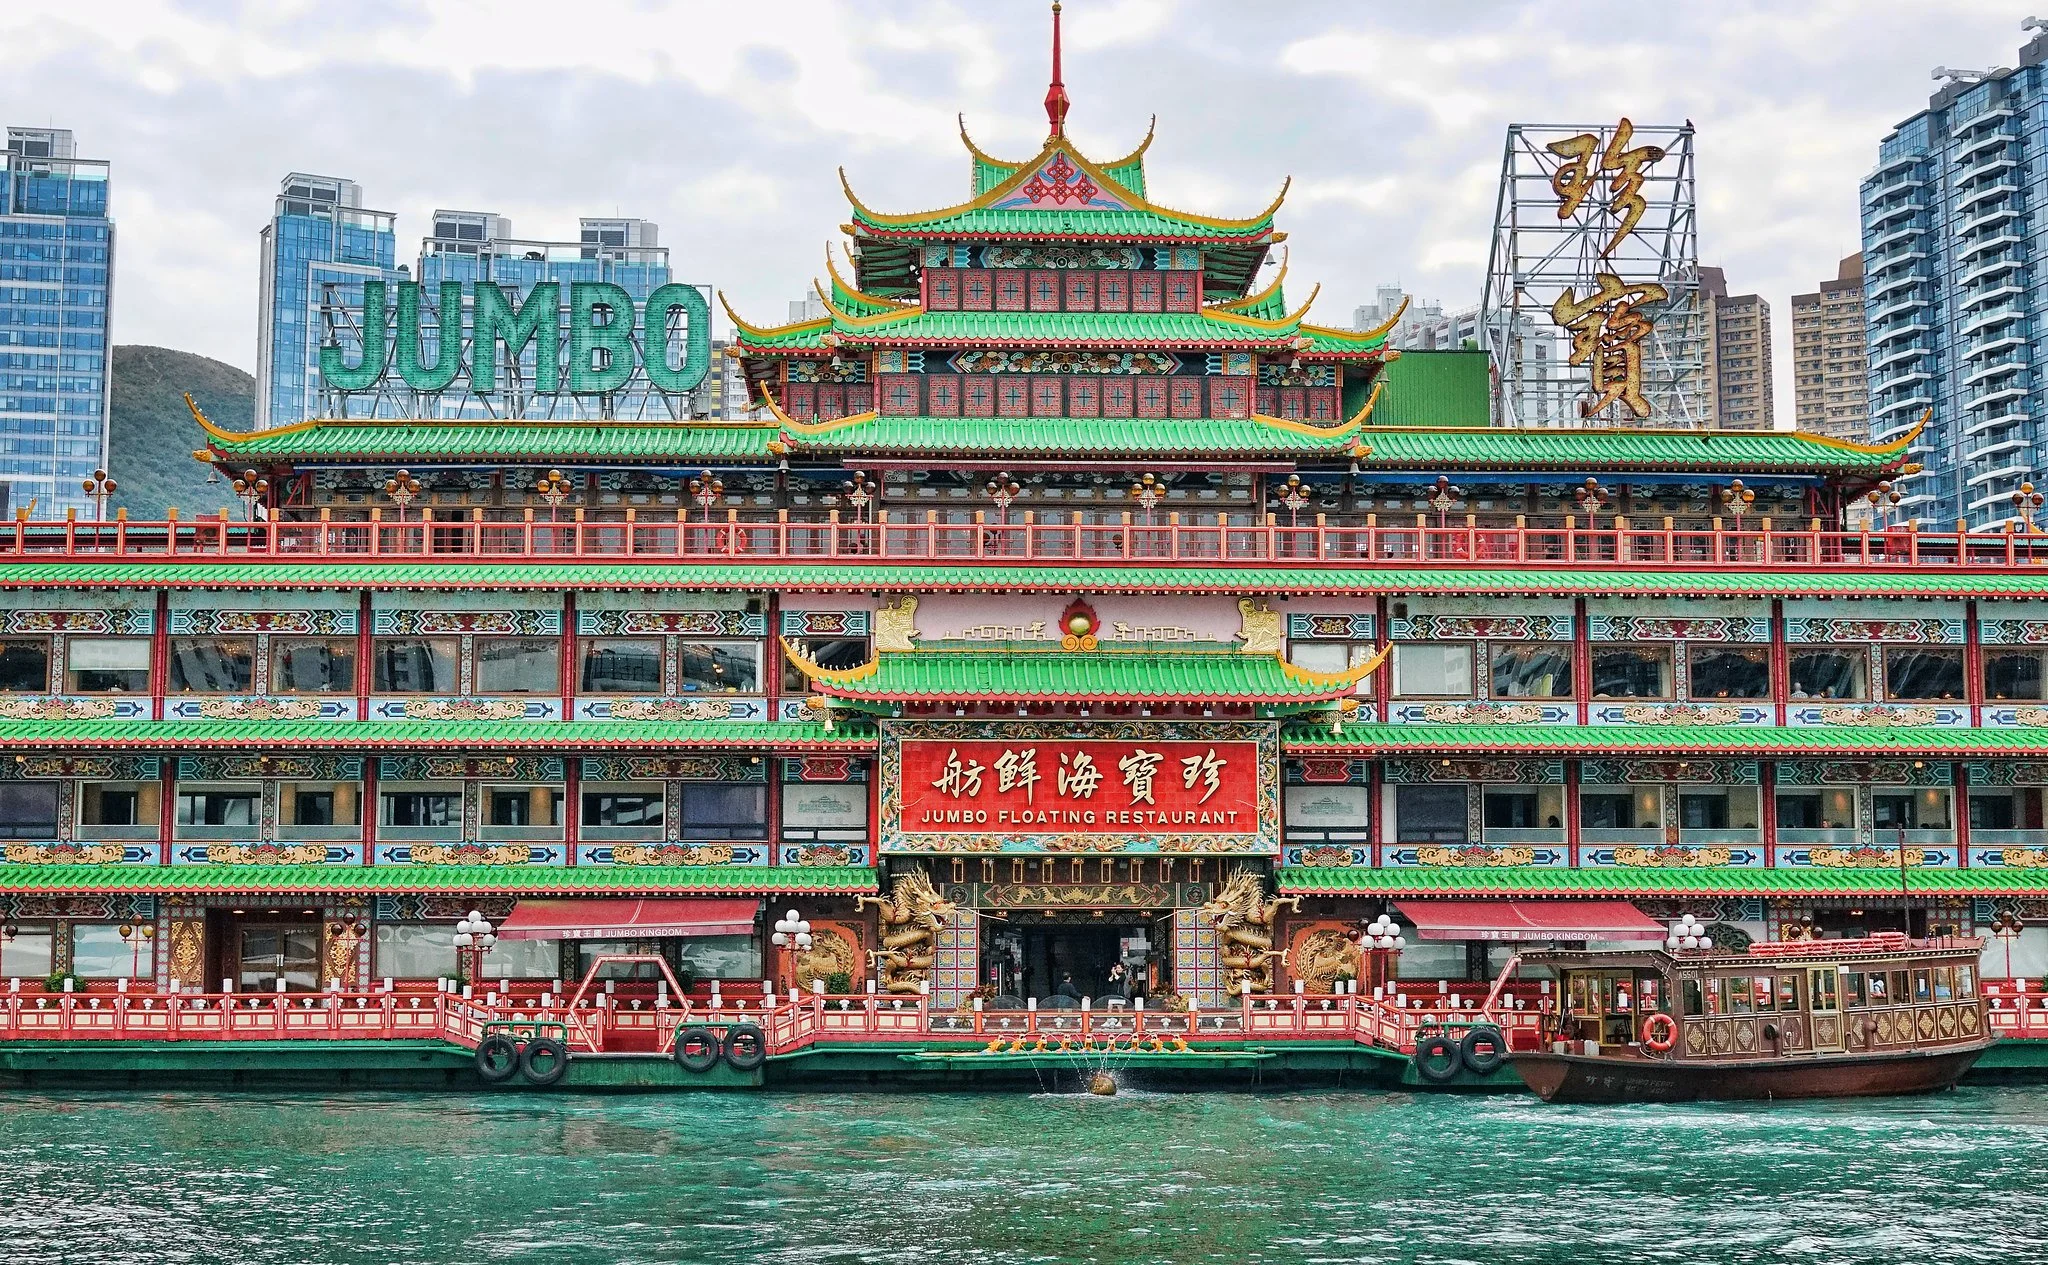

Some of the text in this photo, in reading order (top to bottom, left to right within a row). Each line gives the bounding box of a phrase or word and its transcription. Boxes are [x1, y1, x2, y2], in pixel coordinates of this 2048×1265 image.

[1546, 117, 1668, 419] 珍寶
[319, 280, 709, 395] JUMBO
[922, 810, 1238, 825] JUMBO FLOATING RESTAURANT
[605, 930, 638, 938] JUMBO
[639, 928, 682, 937] KINGDOM
[1522, 932, 1554, 940] JUMBO
[1556, 932, 1598, 940] KINGDOM
